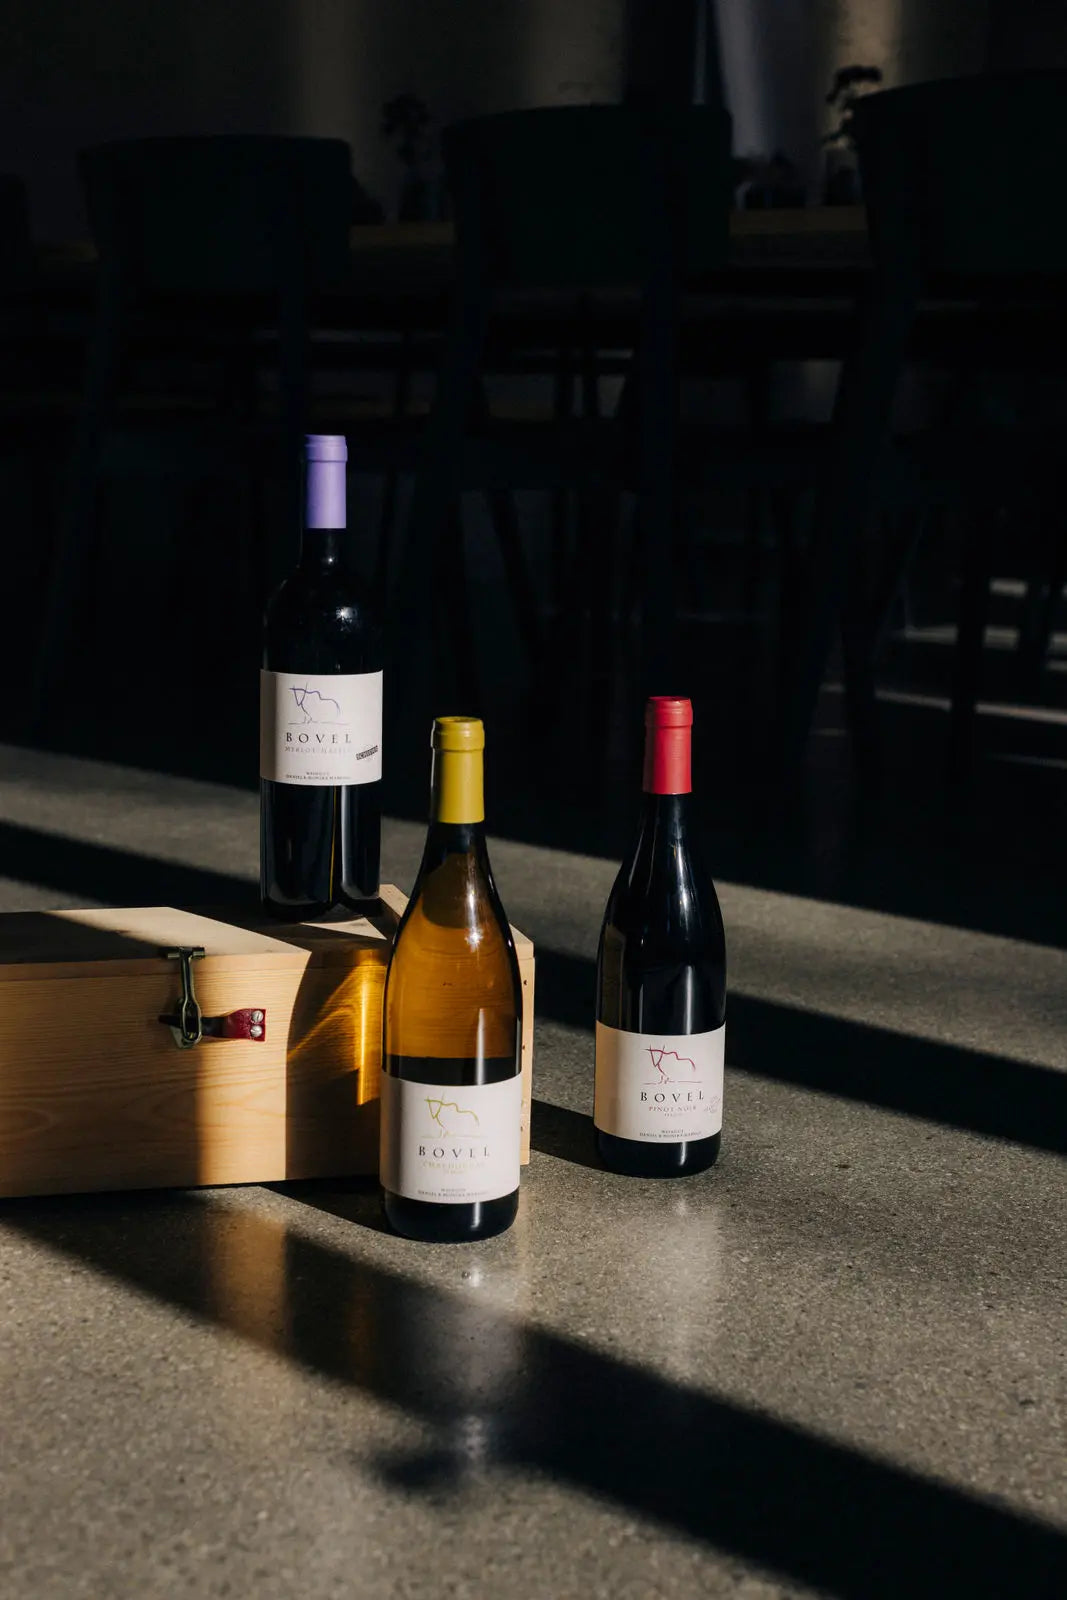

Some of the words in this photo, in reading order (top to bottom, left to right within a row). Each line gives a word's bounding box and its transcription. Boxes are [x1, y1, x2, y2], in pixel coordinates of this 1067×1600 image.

[286, 732, 352, 744] BOVEL
[640, 1091, 704, 1103] BOVEL
[648, 1105, 676, 1113] PINOT
[677, 1105, 696, 1113] NOIR
[418, 1145, 490, 1158] BOVEL
